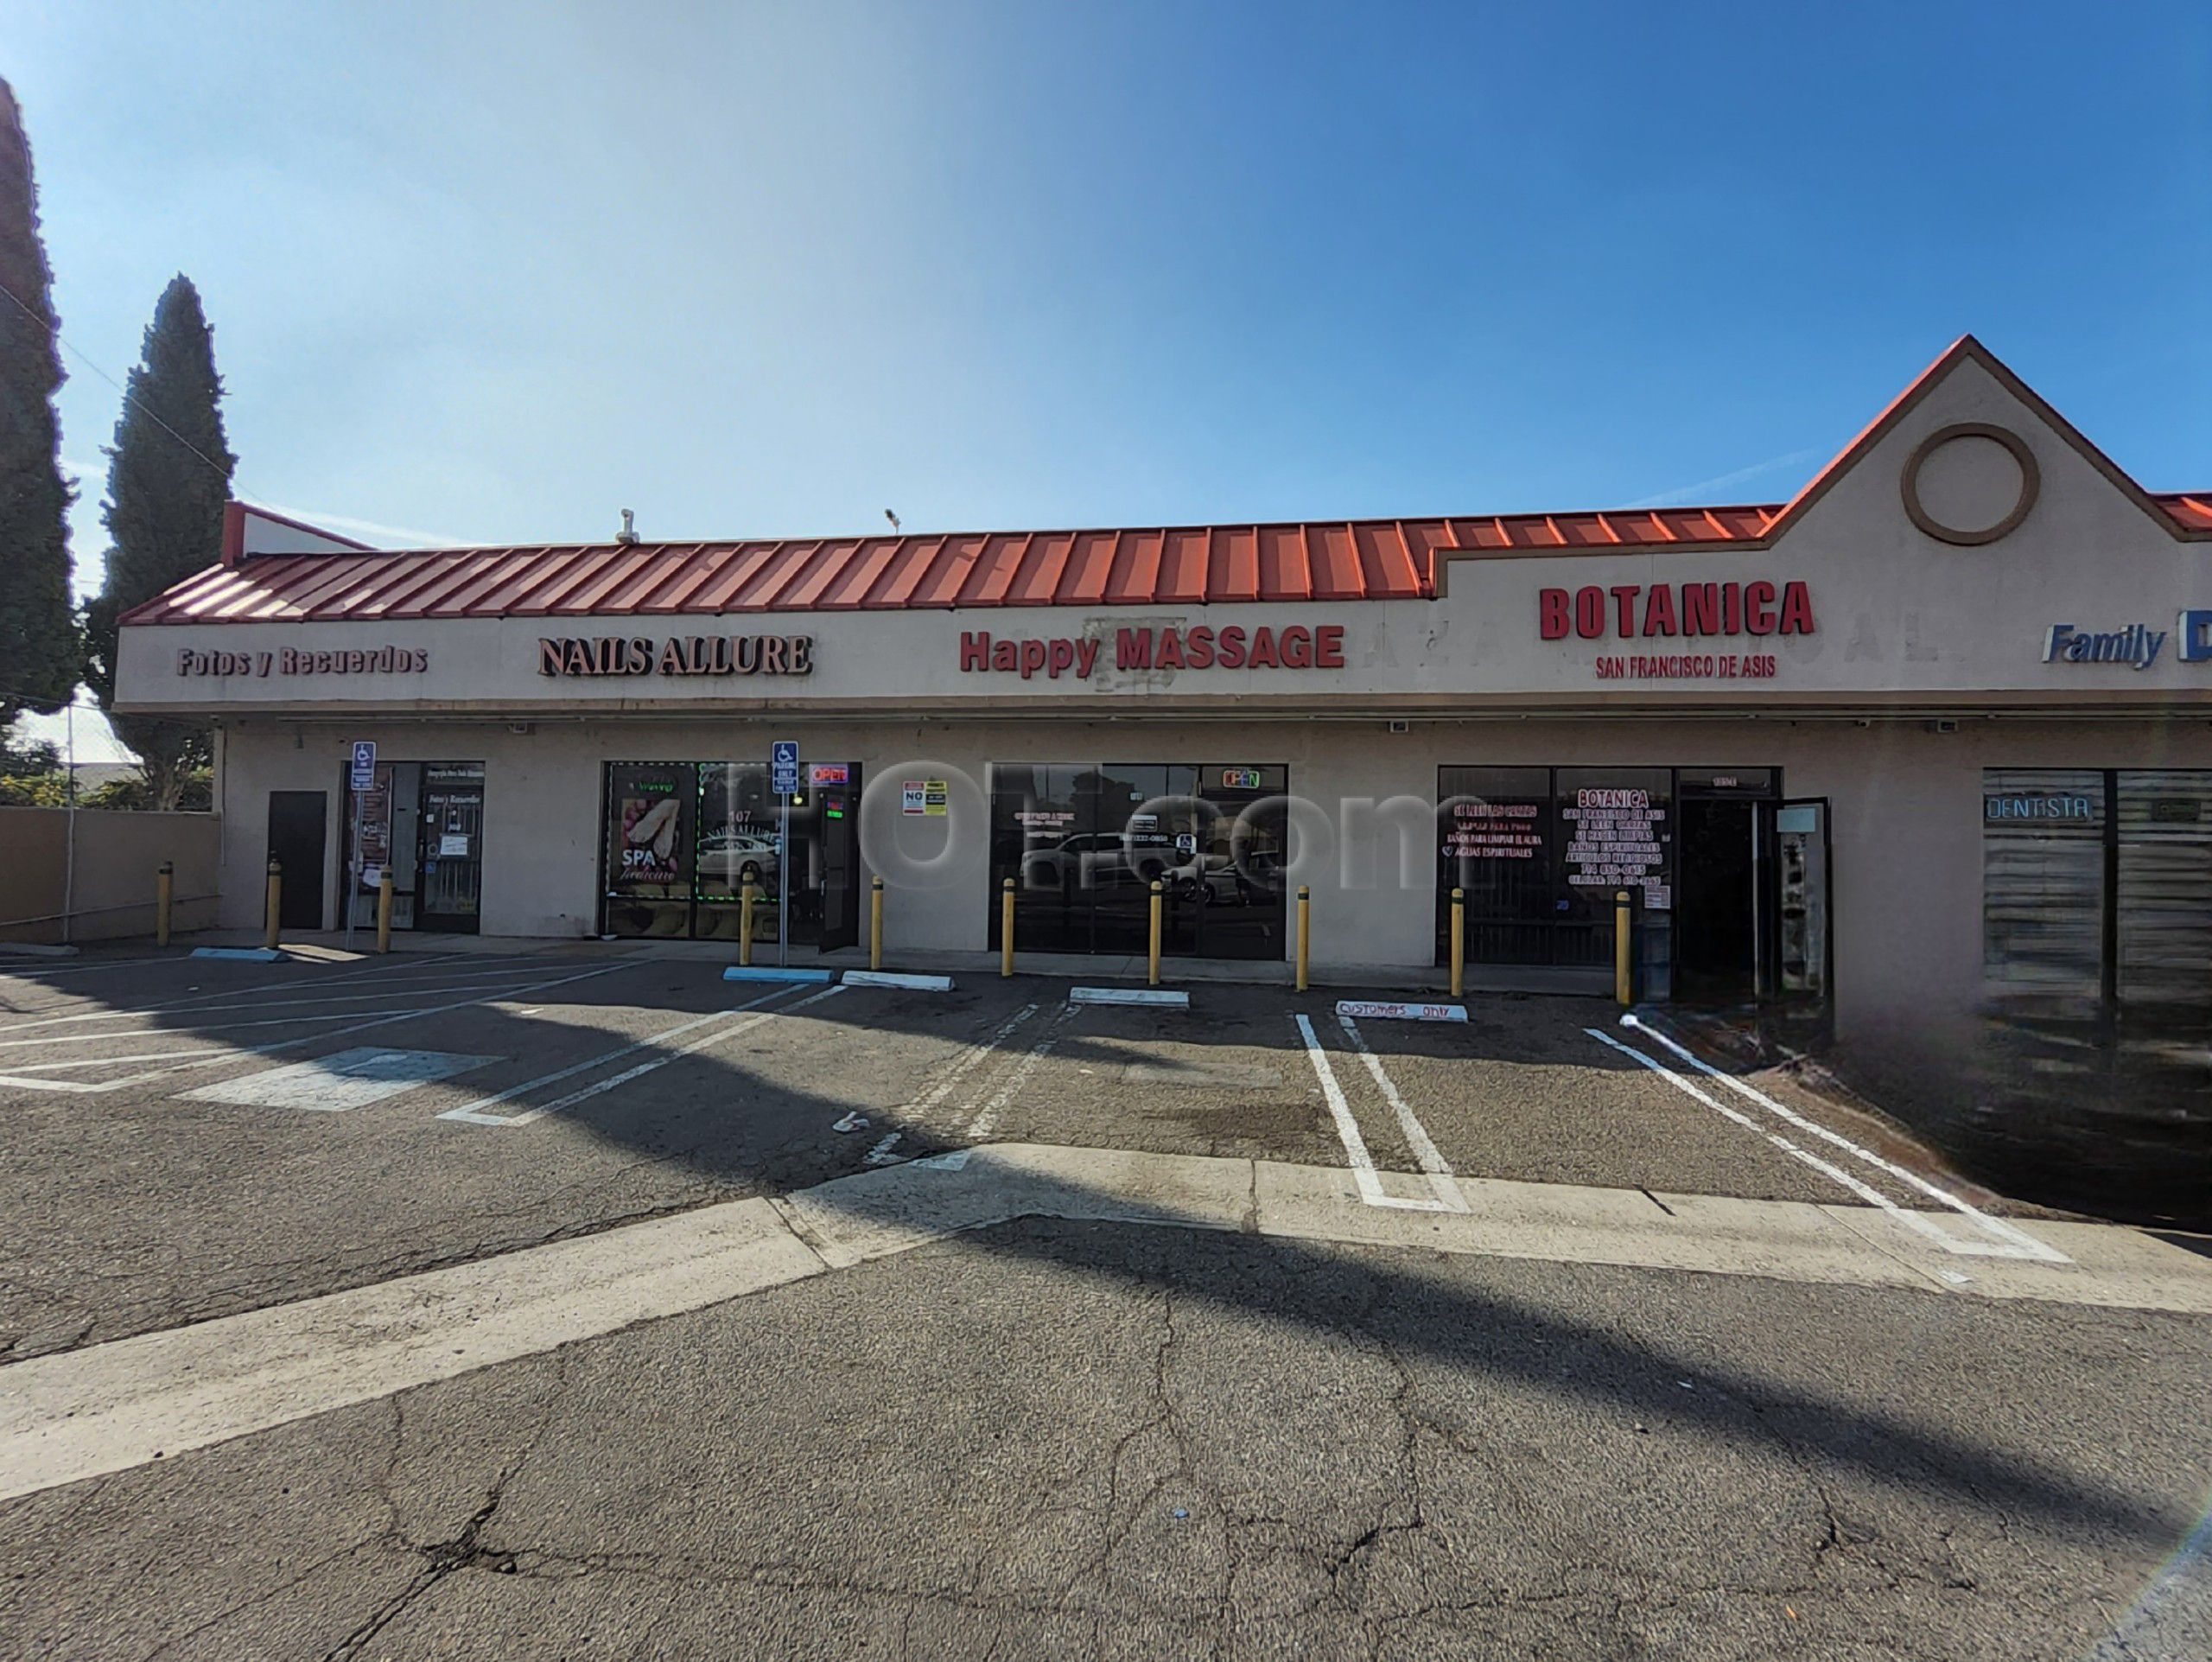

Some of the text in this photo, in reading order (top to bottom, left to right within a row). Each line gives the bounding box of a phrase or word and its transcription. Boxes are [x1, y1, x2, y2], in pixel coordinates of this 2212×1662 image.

[1539, 580, 1815, 640] BOTANICA
[537, 635, 815, 676] NAILS ALLURE
[960, 631, 1099, 678] Happy
[1116, 625, 1345, 671] MASSAGE
[2041, 623, 2167, 671] Family
[176, 645, 429, 678] Fotos y Recuerdos
[1595, 654, 1777, 679] SAN FRANCISCO DE ASIS
[906, 792, 924, 801] NO
[1578, 789, 1649, 808] BOTANICA
[1986, 797, 2089, 818] DENTISTA
[729, 810, 752, 824] 107
[621, 850, 657, 867] SPA
